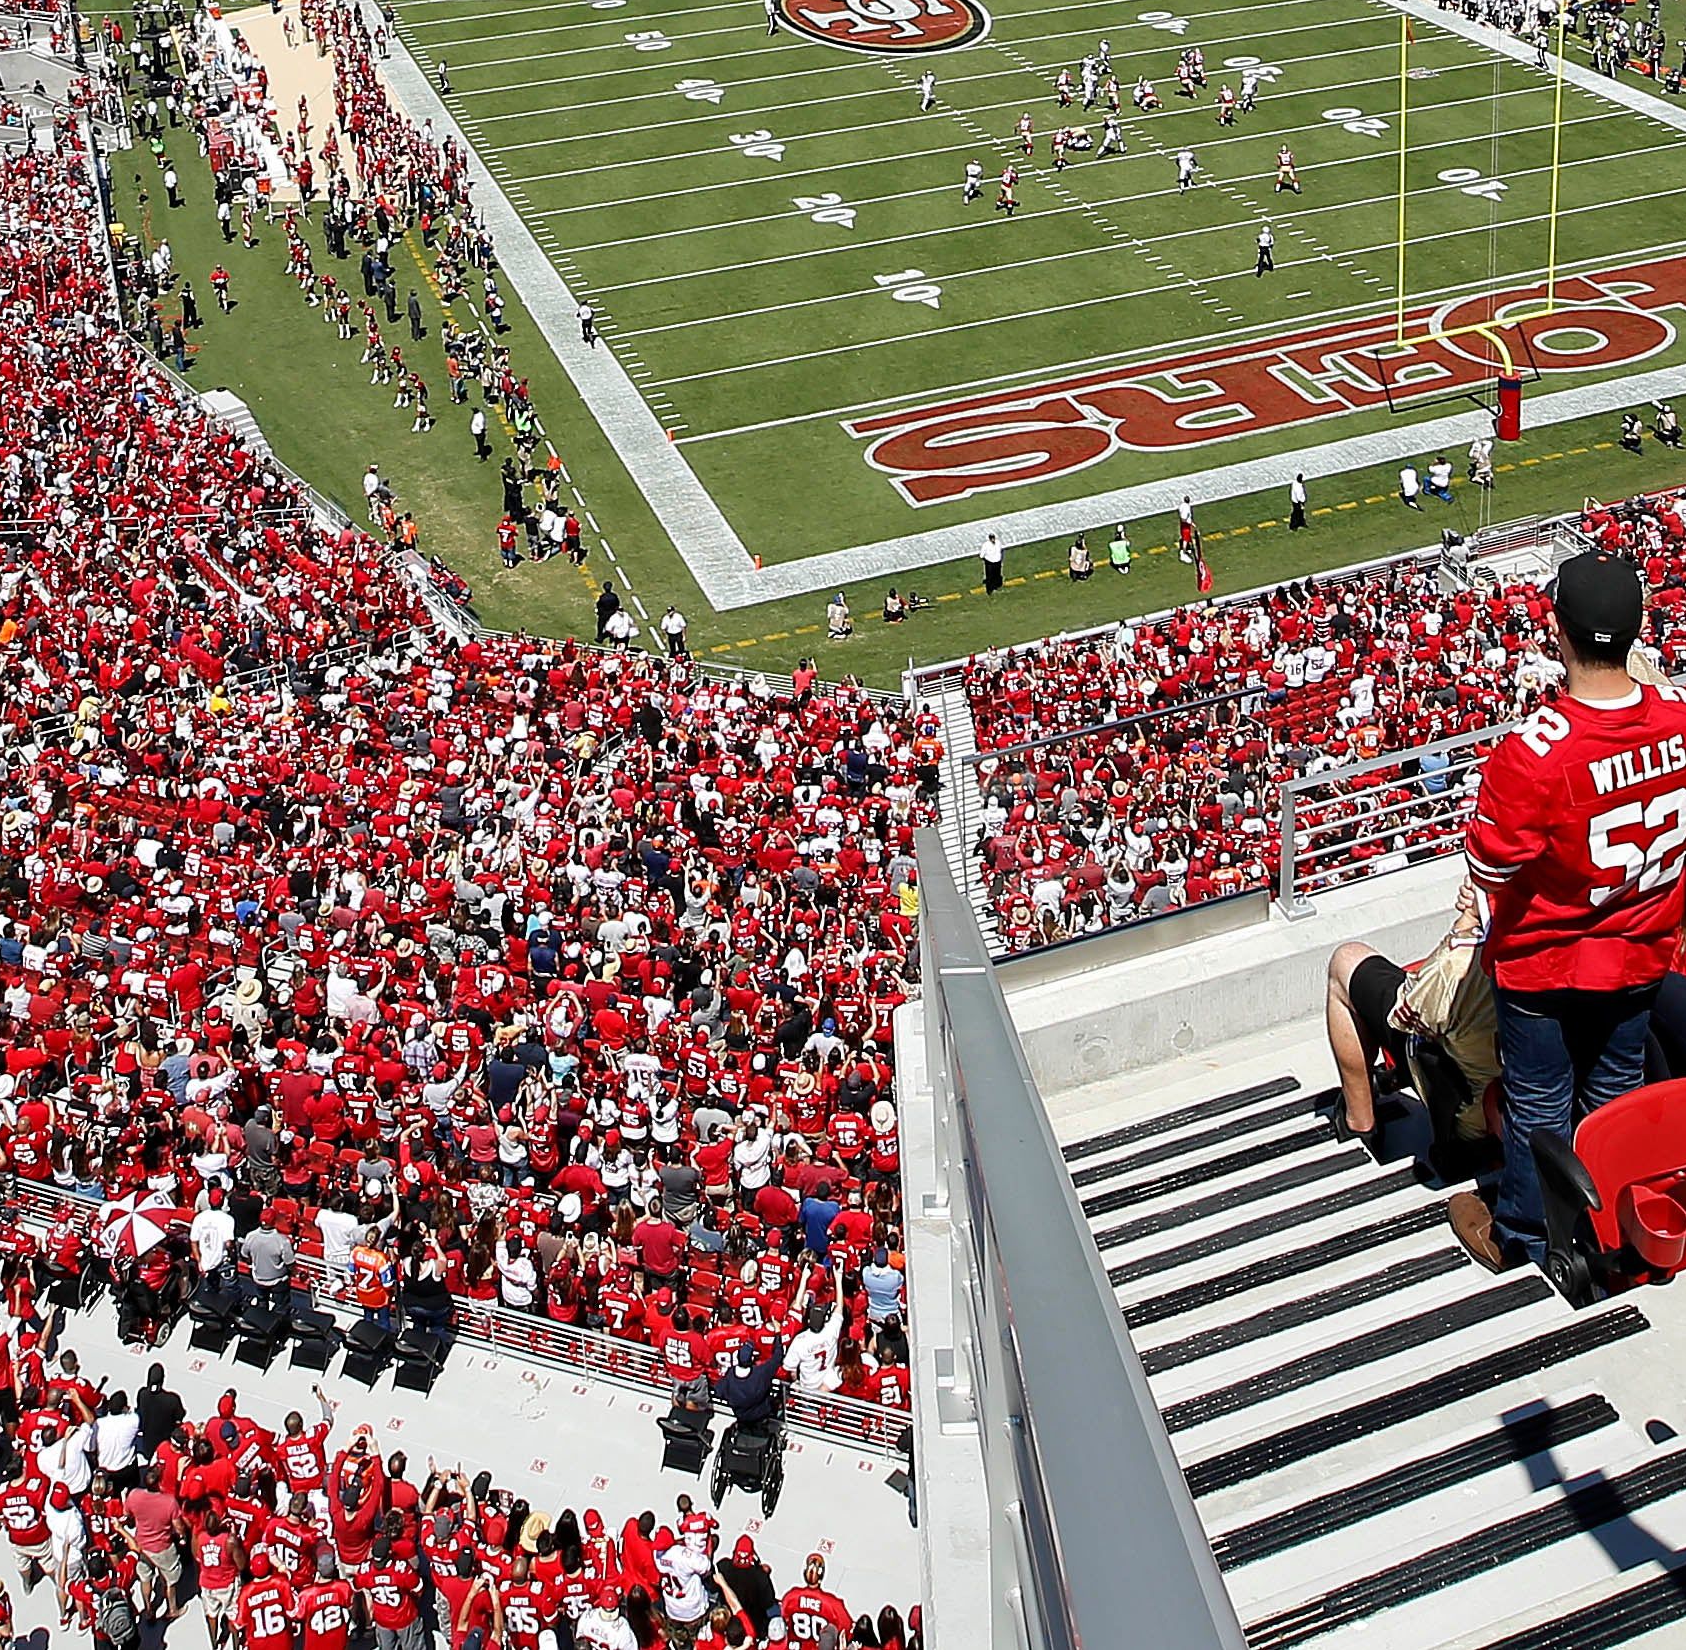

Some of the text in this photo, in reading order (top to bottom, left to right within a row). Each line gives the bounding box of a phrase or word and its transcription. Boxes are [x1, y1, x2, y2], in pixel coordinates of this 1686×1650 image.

[1136, 10, 1190, 32] 40
[624, 29, 672, 51] 50
[1222, 55, 1283, 81] 30
[674, 77, 724, 102] 40
[1321, 107, 1391, 135] 20
[728, 128, 786, 159] 30
[1436, 167, 1509, 200] 10
[792, 192, 856, 224] 20
[873, 268, 943, 304] 10
[1589, 736, 1686, 796] WILLIS
[879, 1009, 889, 1027] 7
[451, 1035, 470, 1051] 52
[688, 1059, 707, 1078] 53
[720, 1079, 738, 1093] 85
[355, 1107, 364, 1123] 7
[358, 1267, 374, 1289] 7
[760, 1272, 782, 1291] 52
[611, 1309, 624, 1329] 7
[741, 1305, 763, 1326] 21
[665, 1349, 692, 1368] 52
[815, 1351, 829, 1371] 7
[880, 1386, 901, 1405] 21
[287, 1453, 318, 1479] 52
[2, 1506, 36, 1529] 52
[371, 1586, 401, 1607] 35
[800, 1596, 822, 1610] RICE
[252, 1603, 286, 1638] 16
[311, 1606, 343, 1634] 42
